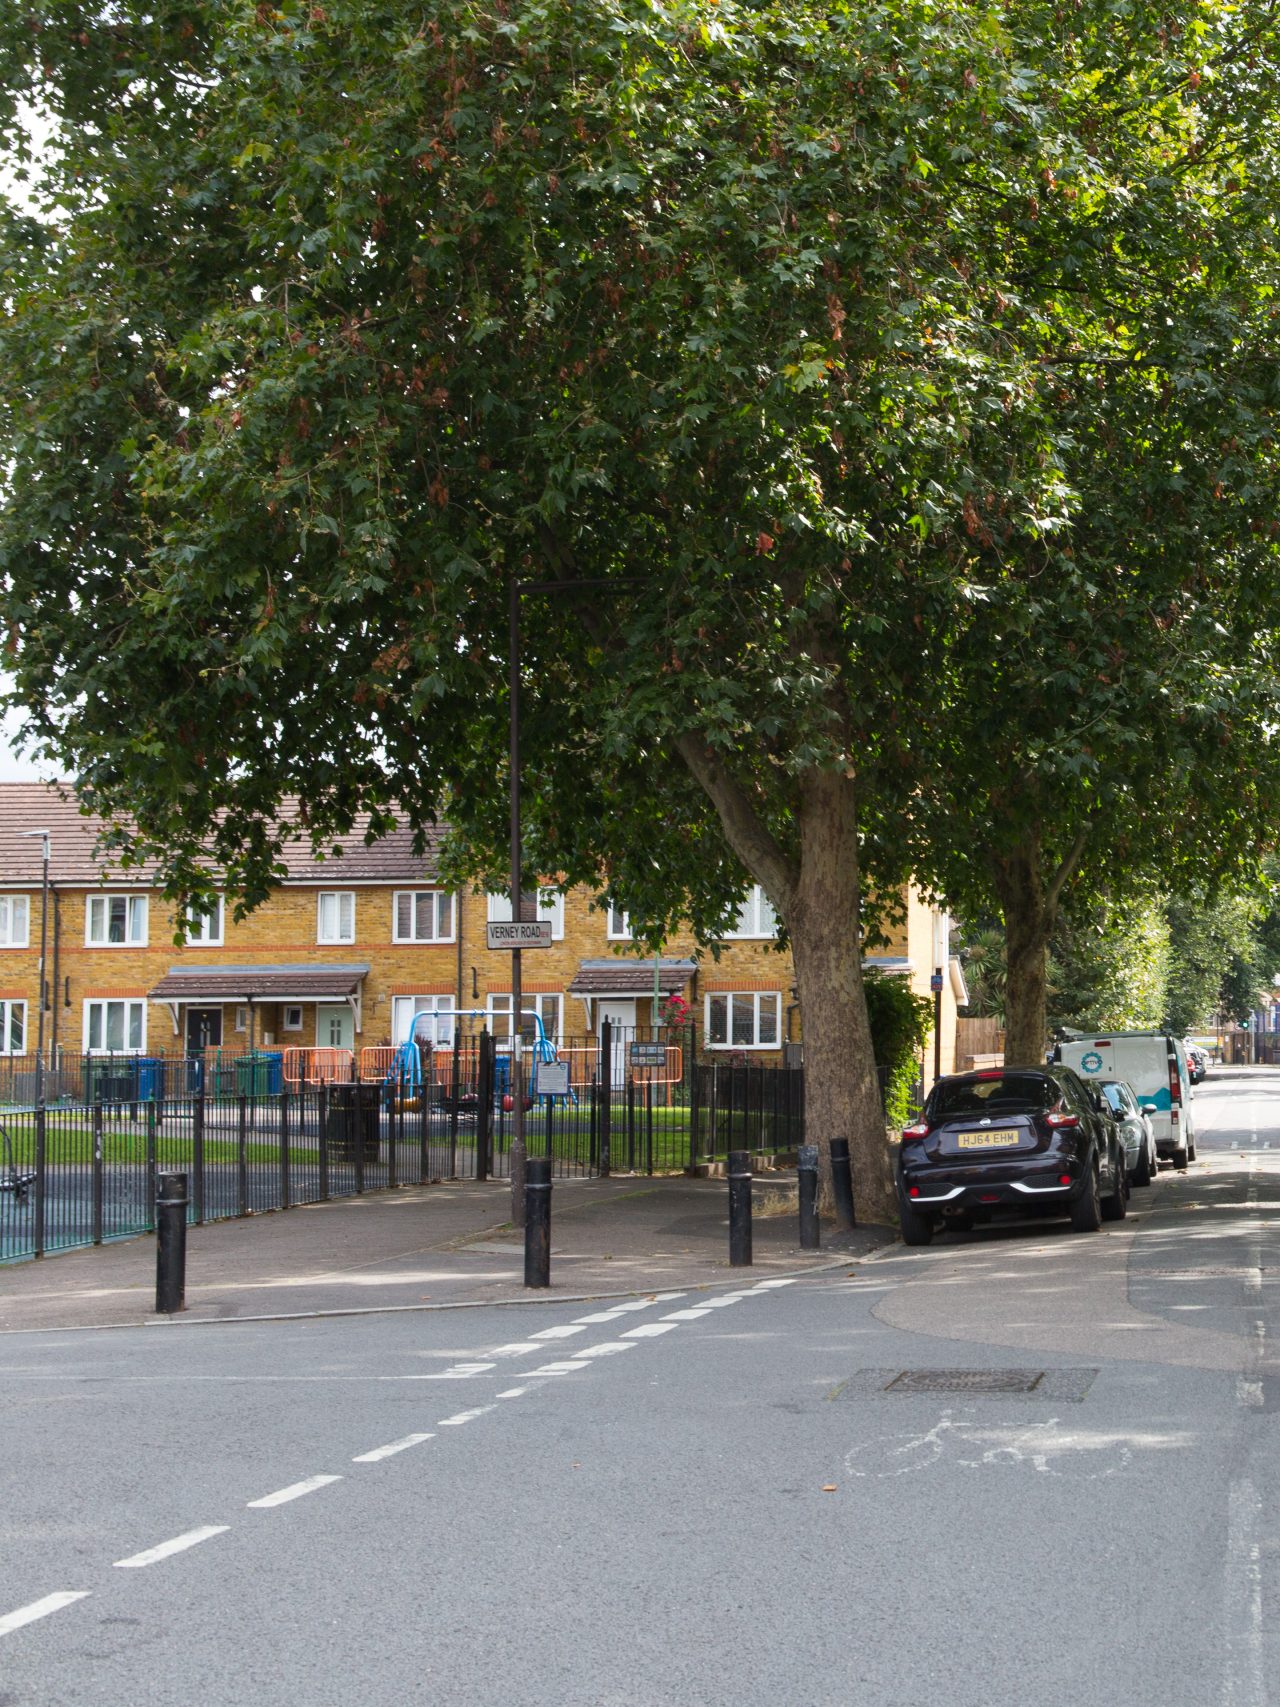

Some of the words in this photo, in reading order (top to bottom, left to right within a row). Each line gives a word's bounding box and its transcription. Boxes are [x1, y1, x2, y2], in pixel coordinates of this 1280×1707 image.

[490, 926, 519, 939] VERNEY
[521, 925, 541, 938] ROAD
[963, 1134, 990, 1146] HJ64
[993, 1132, 1014, 1144] EHM
